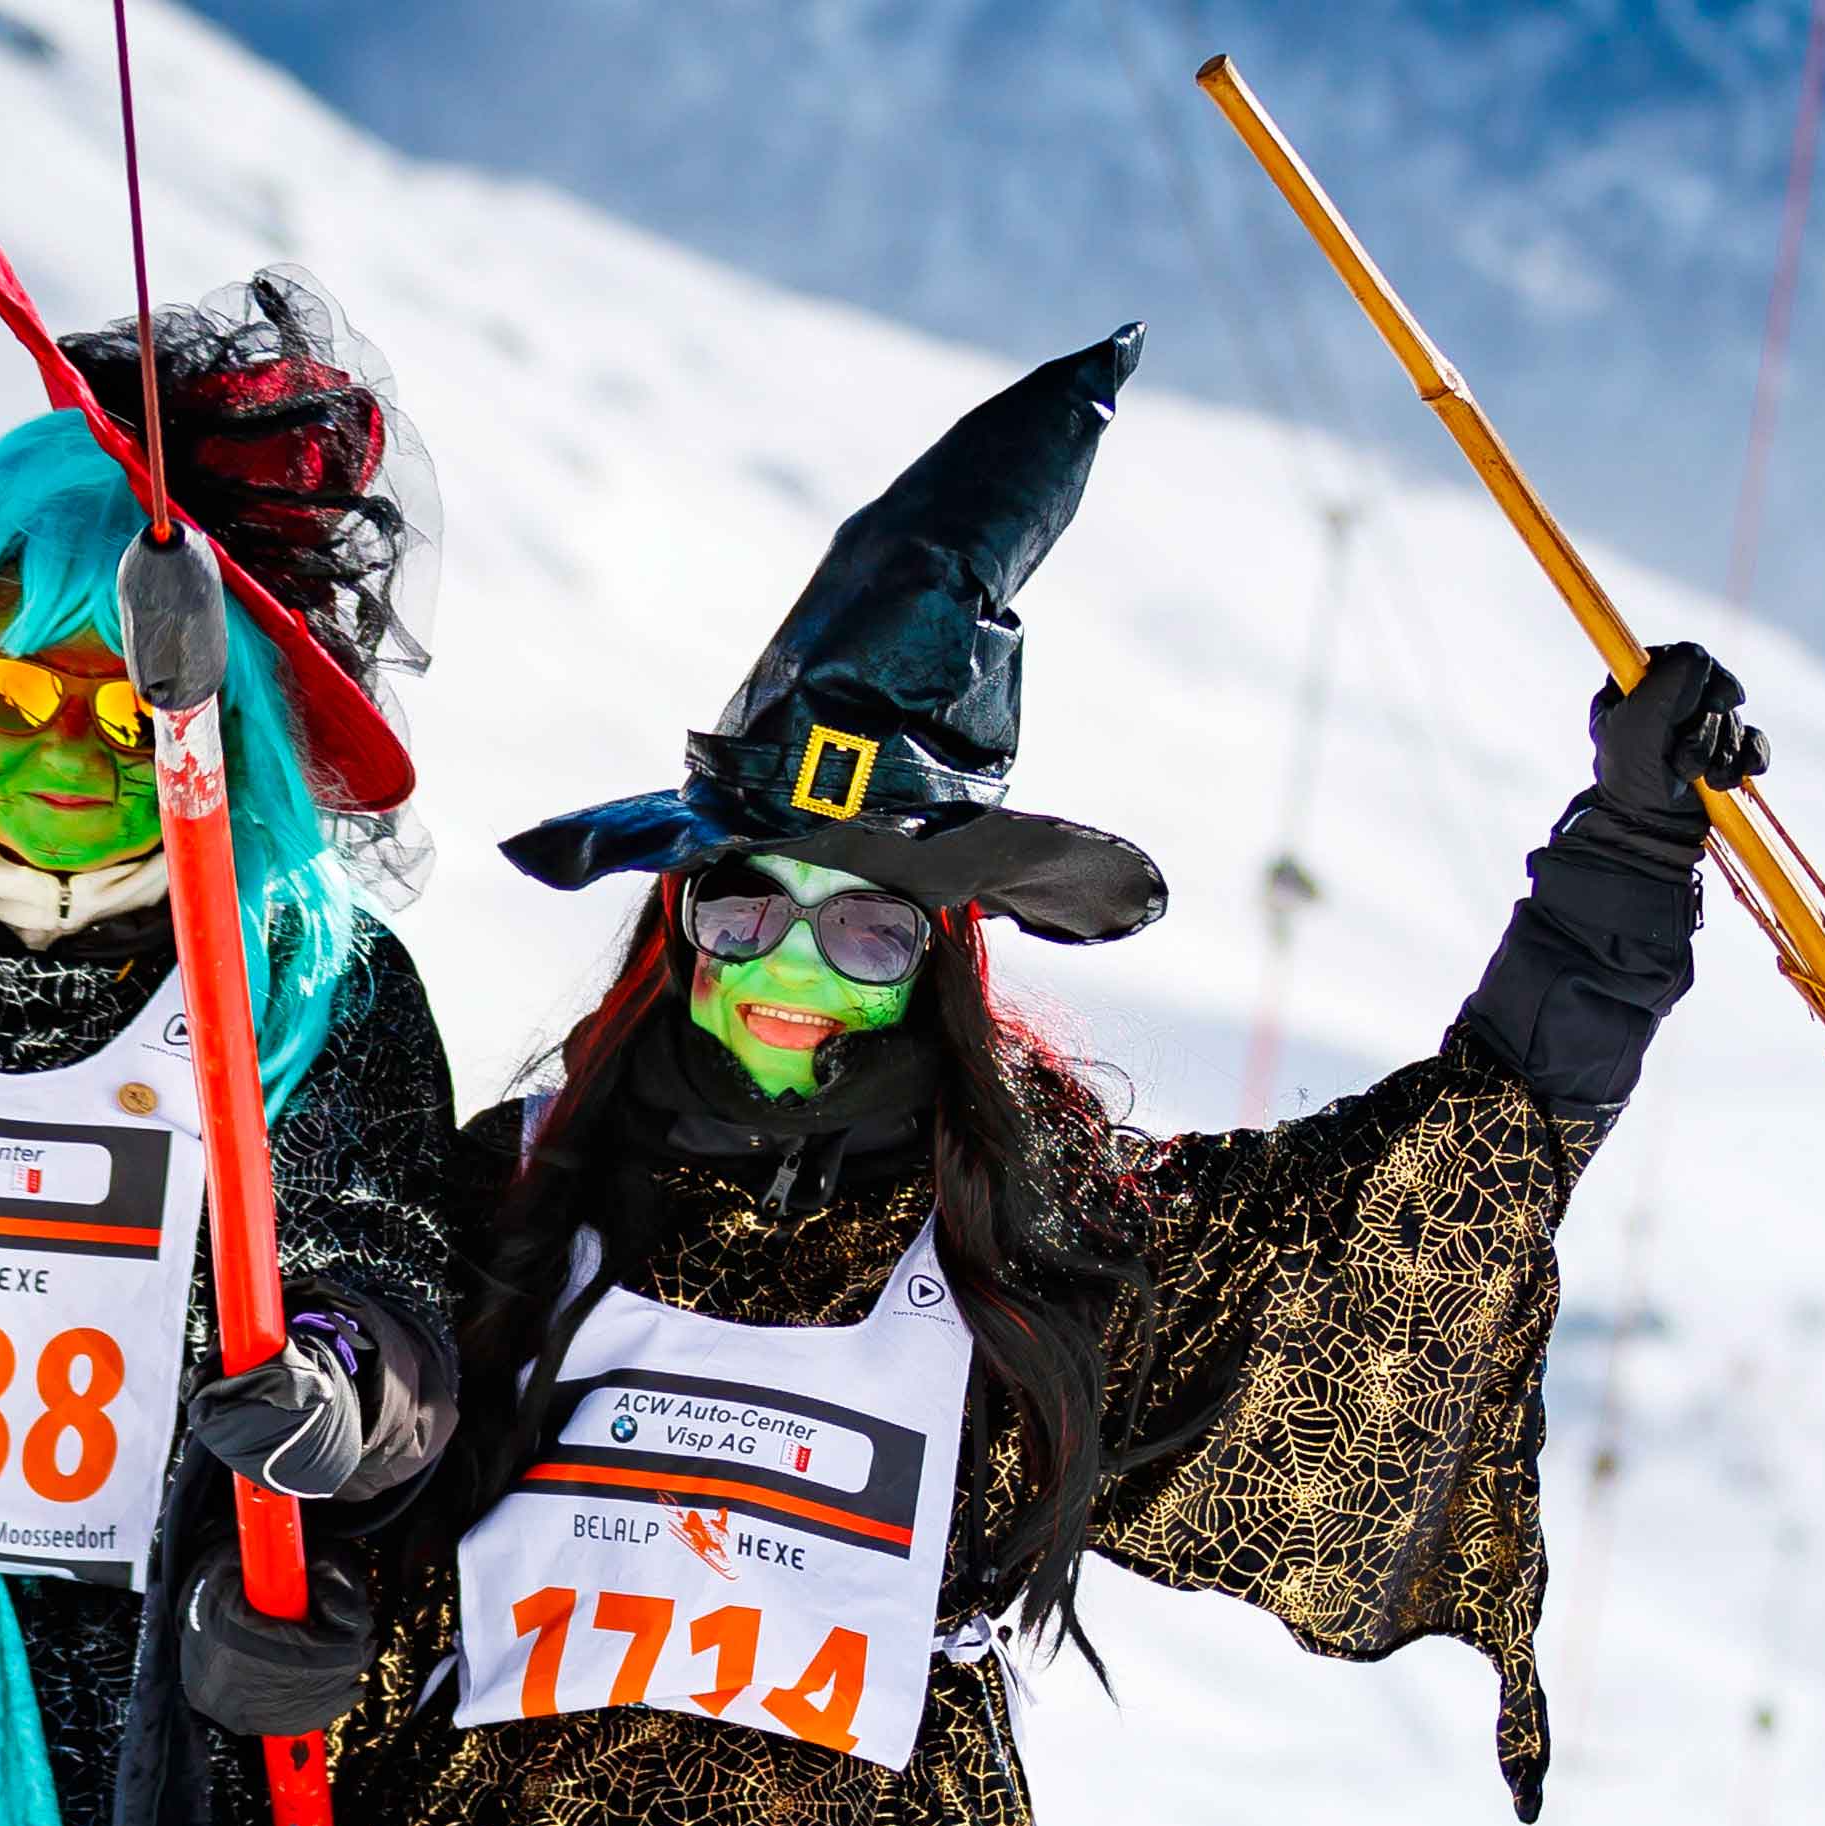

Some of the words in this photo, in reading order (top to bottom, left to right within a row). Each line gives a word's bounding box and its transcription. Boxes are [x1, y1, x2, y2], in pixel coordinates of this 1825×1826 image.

[614, 1392, 675, 1416] ACW
[675, 1400, 818, 1441] Auto-Center
[665, 1425, 714, 1453] Visp
[718, 1432, 758, 1455] AG
[573, 1513, 660, 1545] BELALP
[737, 1532, 806, 1571] HEXE
[511, 1586, 868, 1755] 1714
